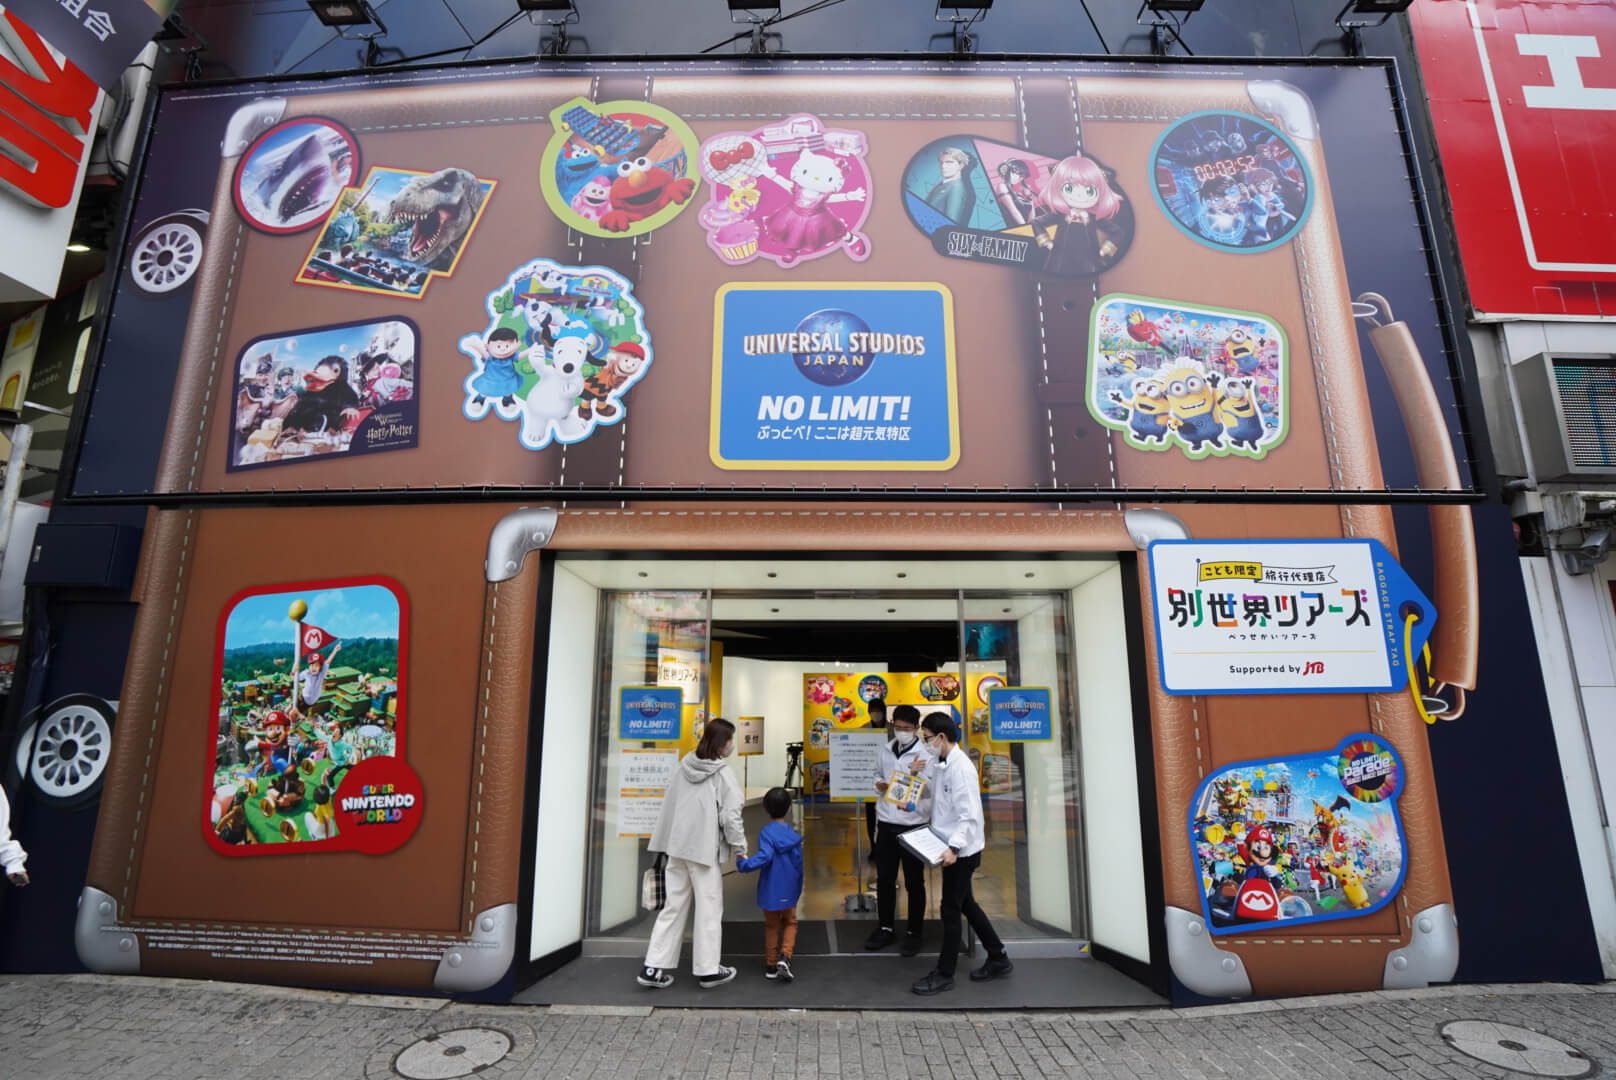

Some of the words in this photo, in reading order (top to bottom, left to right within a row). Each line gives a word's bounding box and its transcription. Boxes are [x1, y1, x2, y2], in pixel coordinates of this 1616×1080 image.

[743, 332, 844, 356] UNIVERSAL
[848, 332, 926, 356] STUDIOS
[803, 355, 864, 366] JAPAN
[757, 395, 805, 421] NO
[808, 395, 912, 421] LIMIT!
[1205, 565, 1258, 577] こども限定
[1265, 569, 1327, 582] 旅行代理店
[1167, 587, 1371, 628] 別世界ツアーズ
[1376, 561, 1391, 609] BAGGAGE
[1384, 612, 1397, 644] STRAP
[1391, 647, 1401, 667] TAG
[1229, 664, 1286, 676] Supported
[1288, 665, 1301, 675] by
[1303, 661, 1325, 676] JTB
[629, 719, 643, 729] NO
[1000, 720, 1013, 729] NO
[1014, 720, 1041, 729] LIMIT!
[362, 783, 395, 796] SUPER
[341, 793, 415, 812] NINTENDO
[352, 808, 403, 825] WORLD
